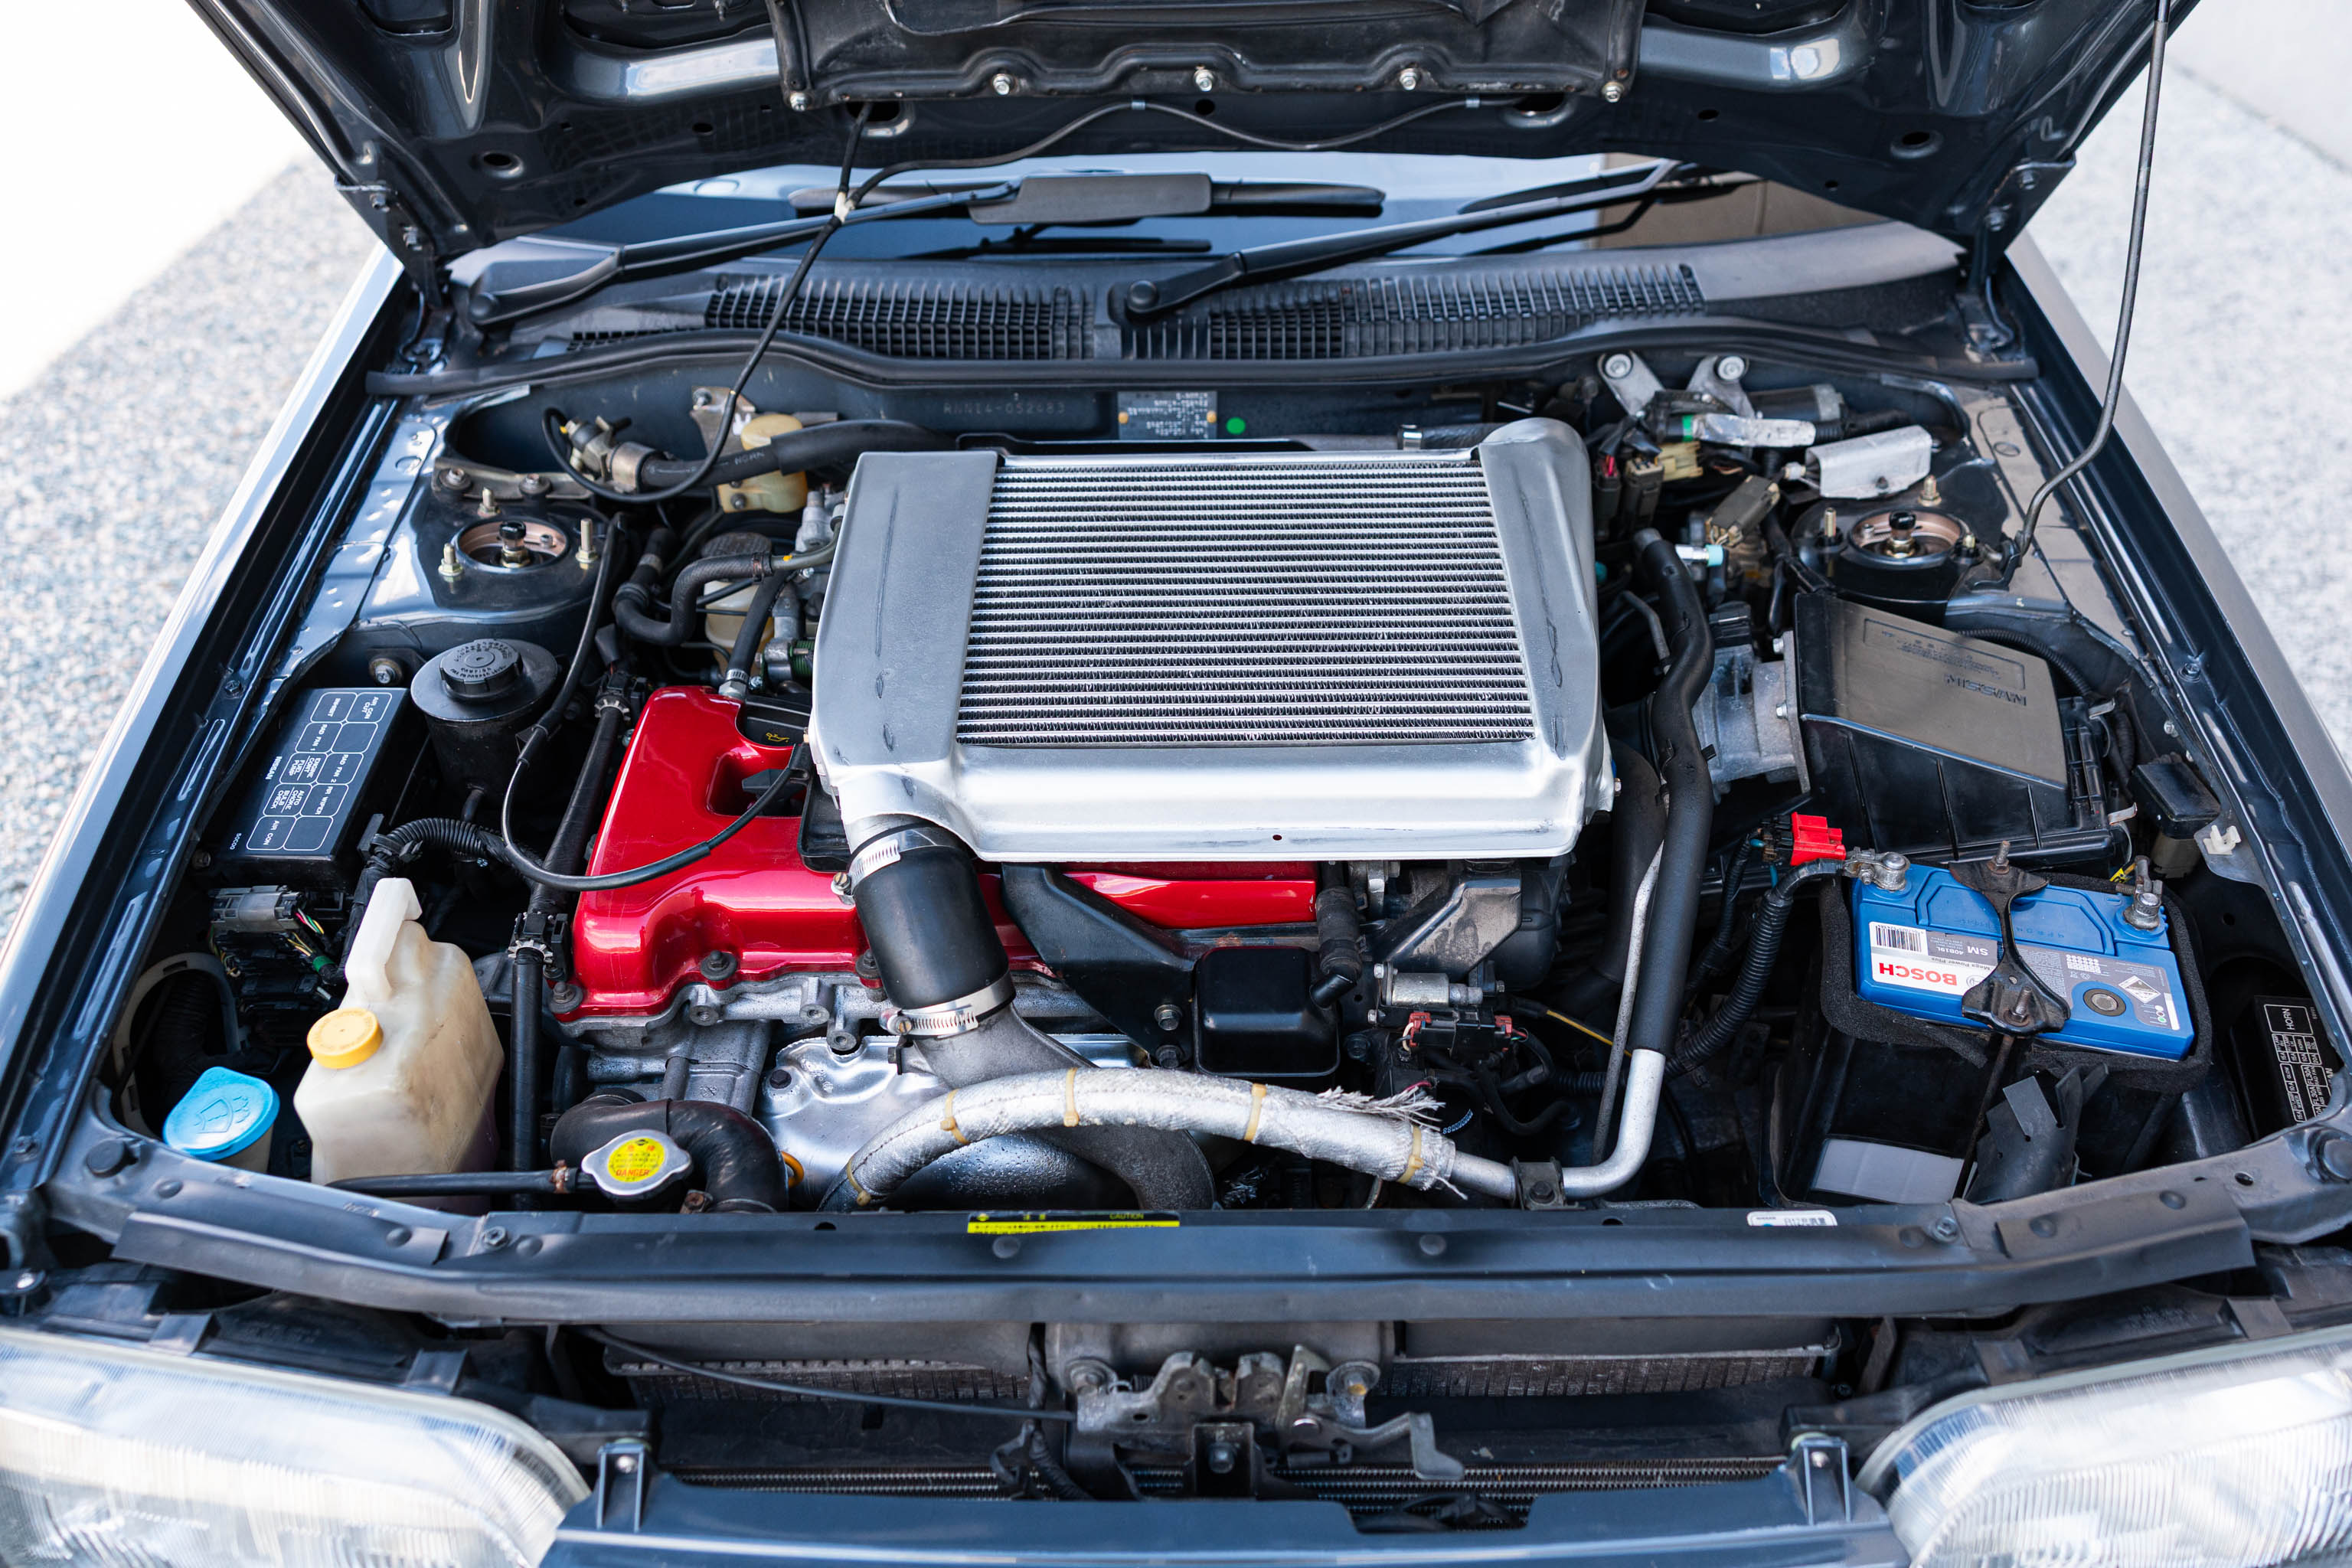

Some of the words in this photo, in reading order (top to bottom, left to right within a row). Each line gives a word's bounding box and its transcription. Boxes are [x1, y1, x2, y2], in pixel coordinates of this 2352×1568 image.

[1945, 674, 2028, 707] NISSAN
[361, 702, 371, 713] CUT
[370, 697, 379, 706] AIR
[363, 707, 374, 719] CON
[318, 724, 328, 735] RAD
[312, 737, 322, 746] FAN
[304, 757, 315, 773] CONT
[339, 754, 349, 765] RAD
[265, 756, 282, 780] NISSAN
[289, 760, 300, 776] PUMP
[293, 760, 305, 775] FUEL
[306, 757, 322, 778] ENGINE
[333, 767, 343, 777] FAN
[270, 790, 284, 809] CHECK
[279, 790, 290, 806] BULB
[286, 790, 299, 809] CHOKE
[293, 790, 305, 805] AUTO
[315, 797, 328, 815] WIPER
[270, 820, 280, 831] AIR
[262, 832, 274, 845] CON
[1936, 946, 1964, 955] 40B19L
[1967, 946, 1988, 956] SM
[1879, 962, 1956, 986] BOSCH
[2282, 1008, 2295, 1030] HORN
[2304, 1066, 2314, 1085] FL30A
[2309, 1086, 2320, 1105] FL30A
